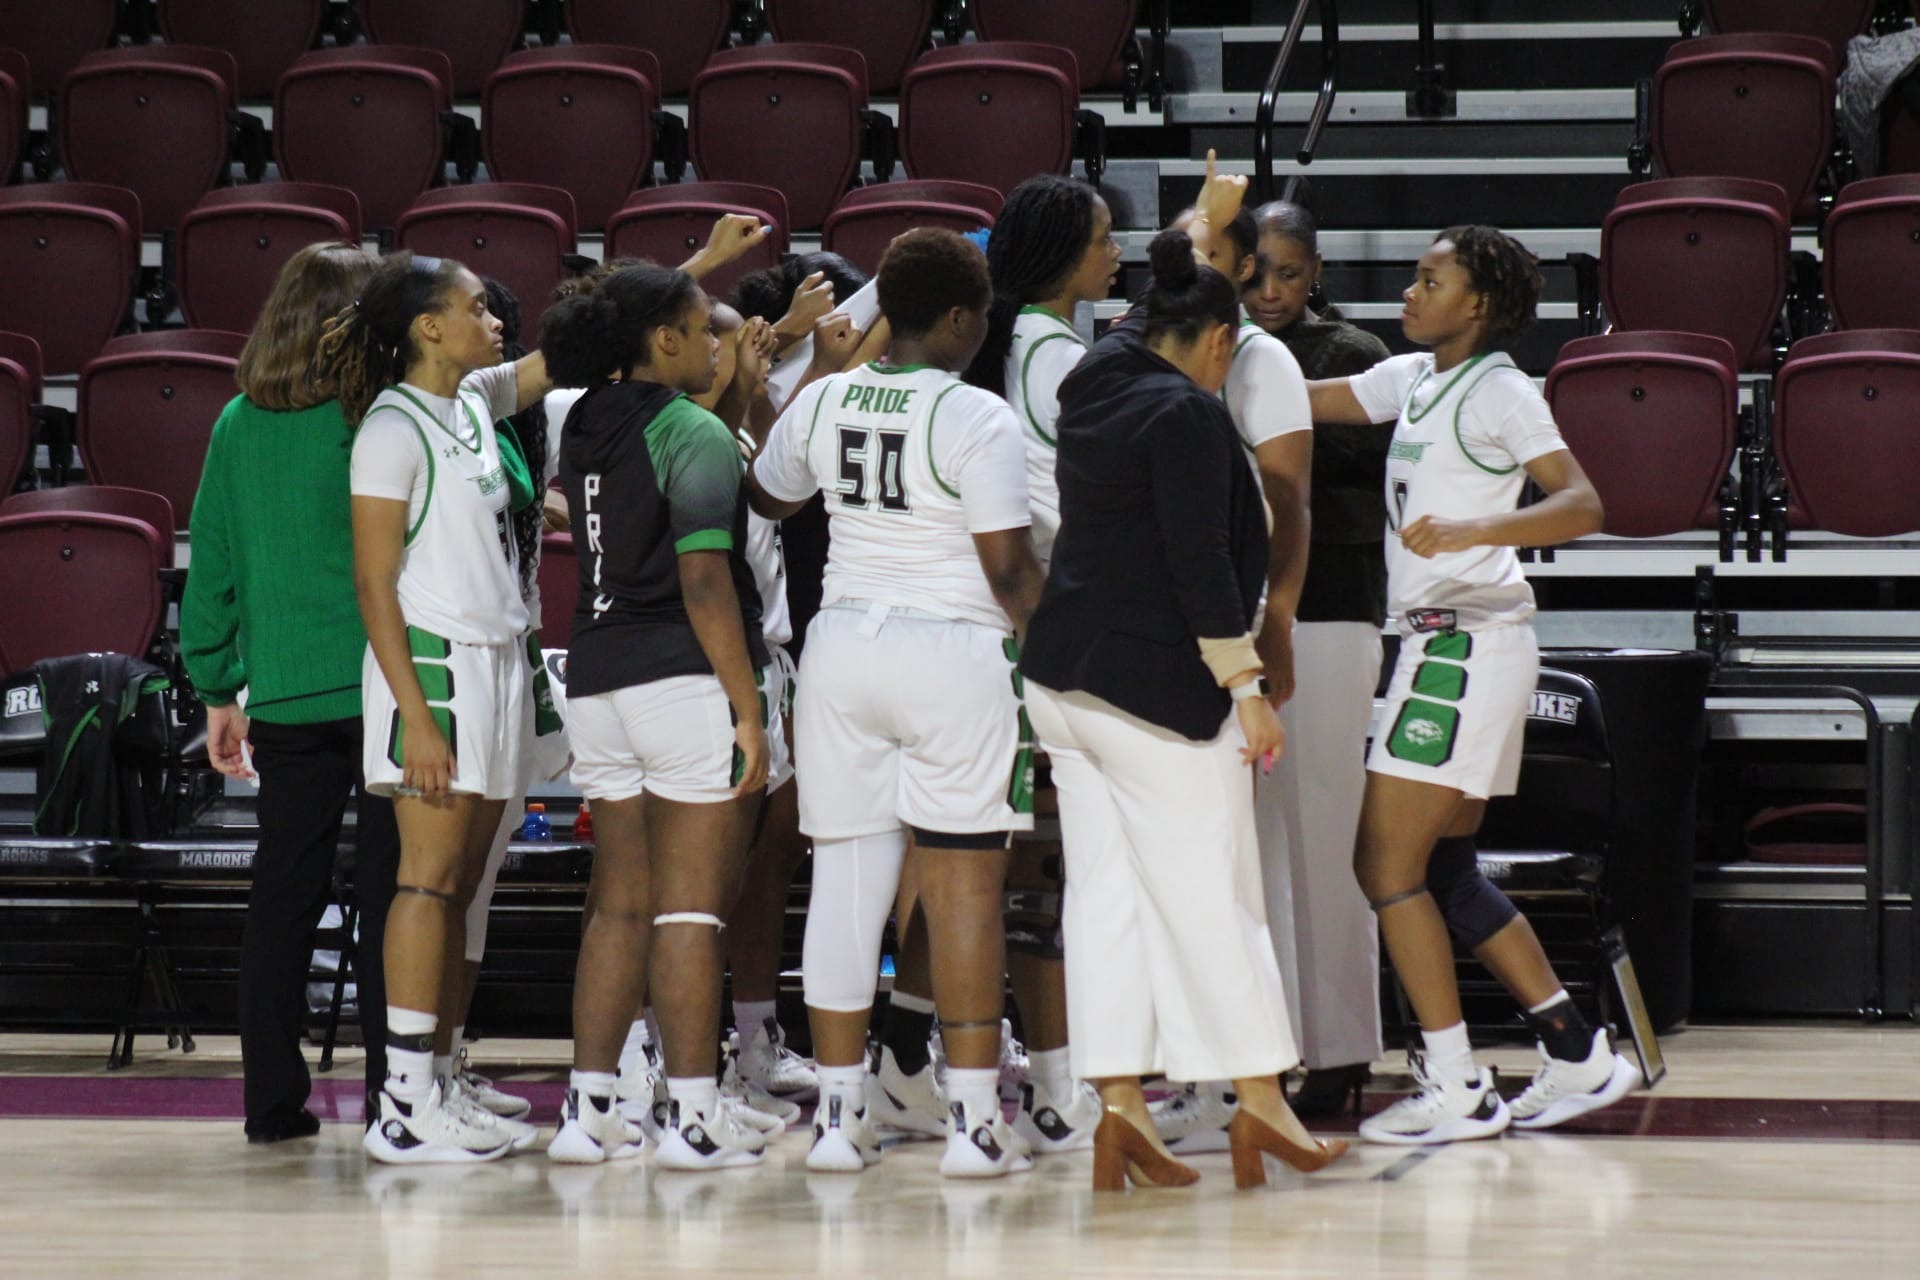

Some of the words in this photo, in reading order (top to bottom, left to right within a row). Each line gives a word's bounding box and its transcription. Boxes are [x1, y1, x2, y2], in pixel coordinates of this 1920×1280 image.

[841, 384, 917, 414] PRIDE
[837, 425, 911, 514] 50
[180, 851, 254, 867] MAROONS
